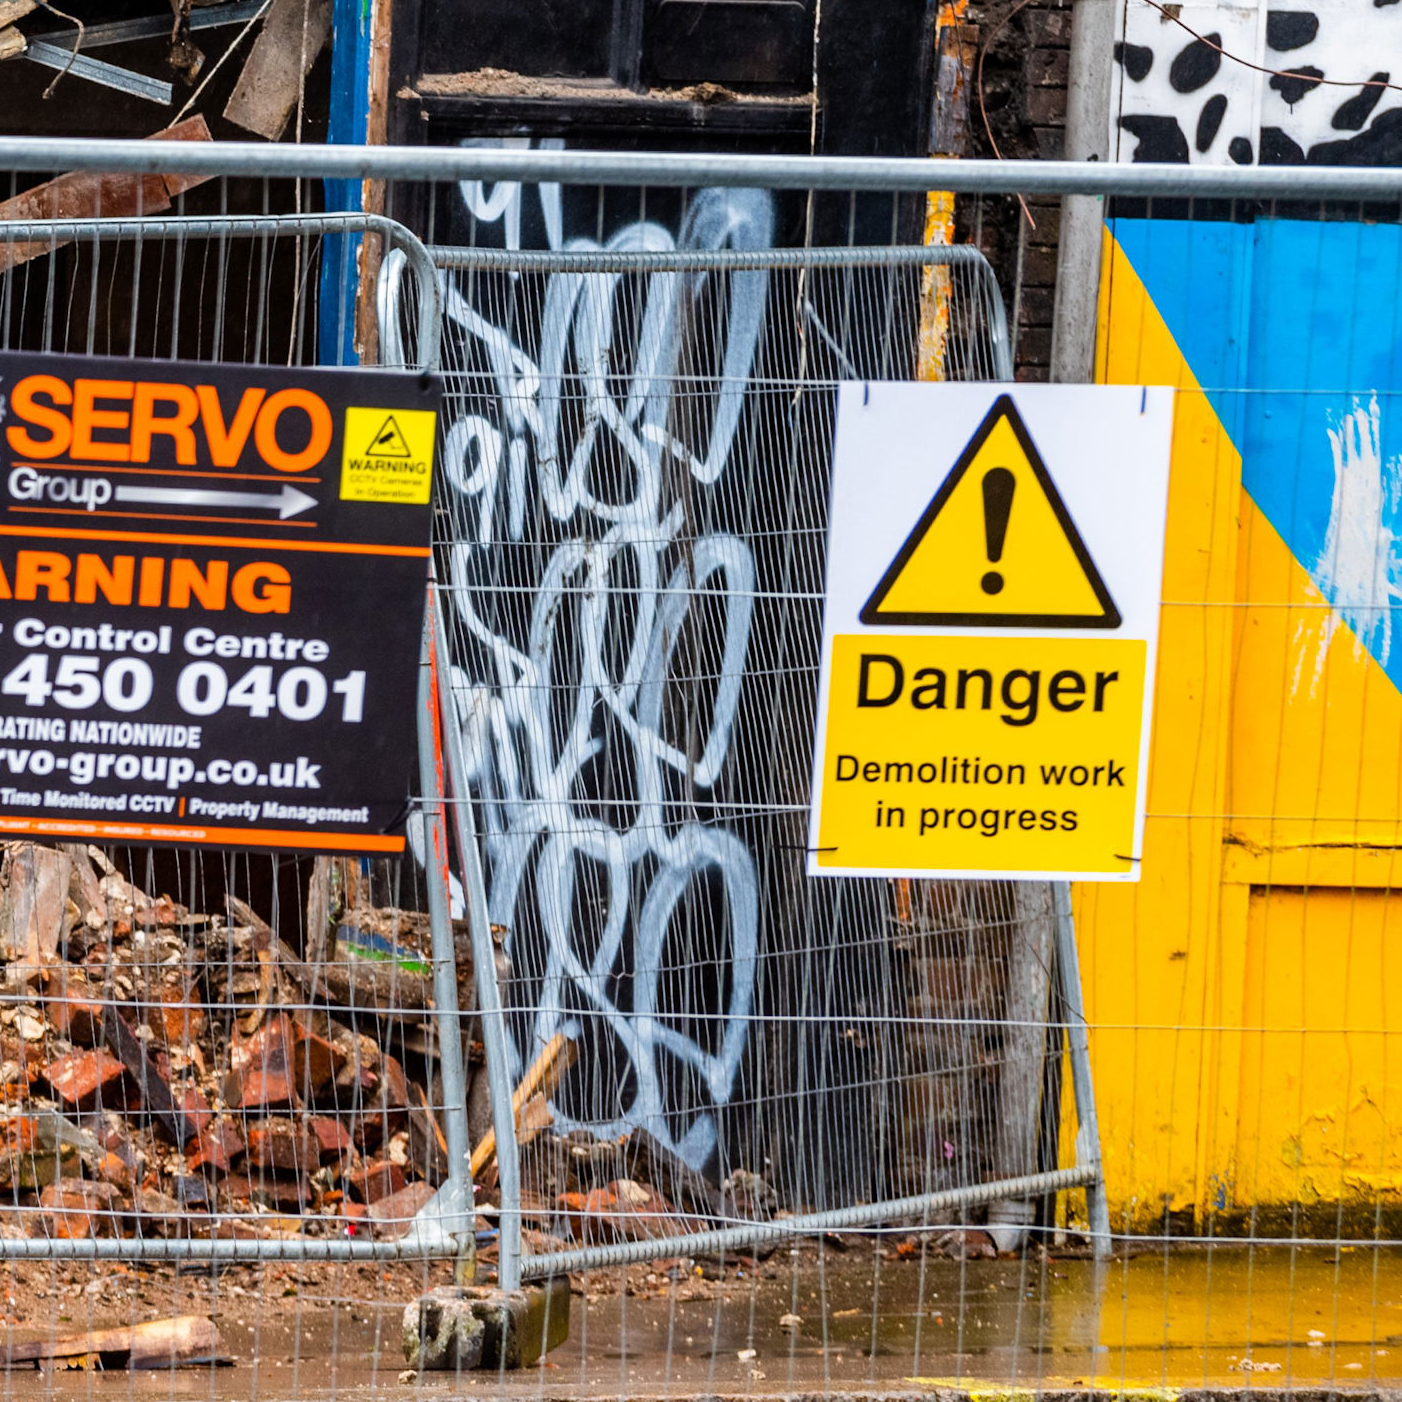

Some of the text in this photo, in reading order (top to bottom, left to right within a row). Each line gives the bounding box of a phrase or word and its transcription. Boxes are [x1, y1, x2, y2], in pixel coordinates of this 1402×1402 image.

[6, 374, 333, 472] SERVO
[348, 459, 427, 475] WARNING
[7, 467, 113, 512] Group
[13, 618, 172, 654] Control
[183, 627, 330, 662] Centre
[1, 653, 153, 711] 450
[177, 661, 366, 722] 0401
[857, 653, 1120, 727] Danger
[70, 720, 202, 748] NATIONWIDE
[835, 754, 1126, 788] Demolition work
[0, 788, 42, 807] Time
[44, 790, 127, 812] Monitored
[129, 795, 176, 813] CCTV
[189, 799, 260, 821] Property
[262, 802, 369, 824] Management
[875, 800, 1078, 838] in progress
